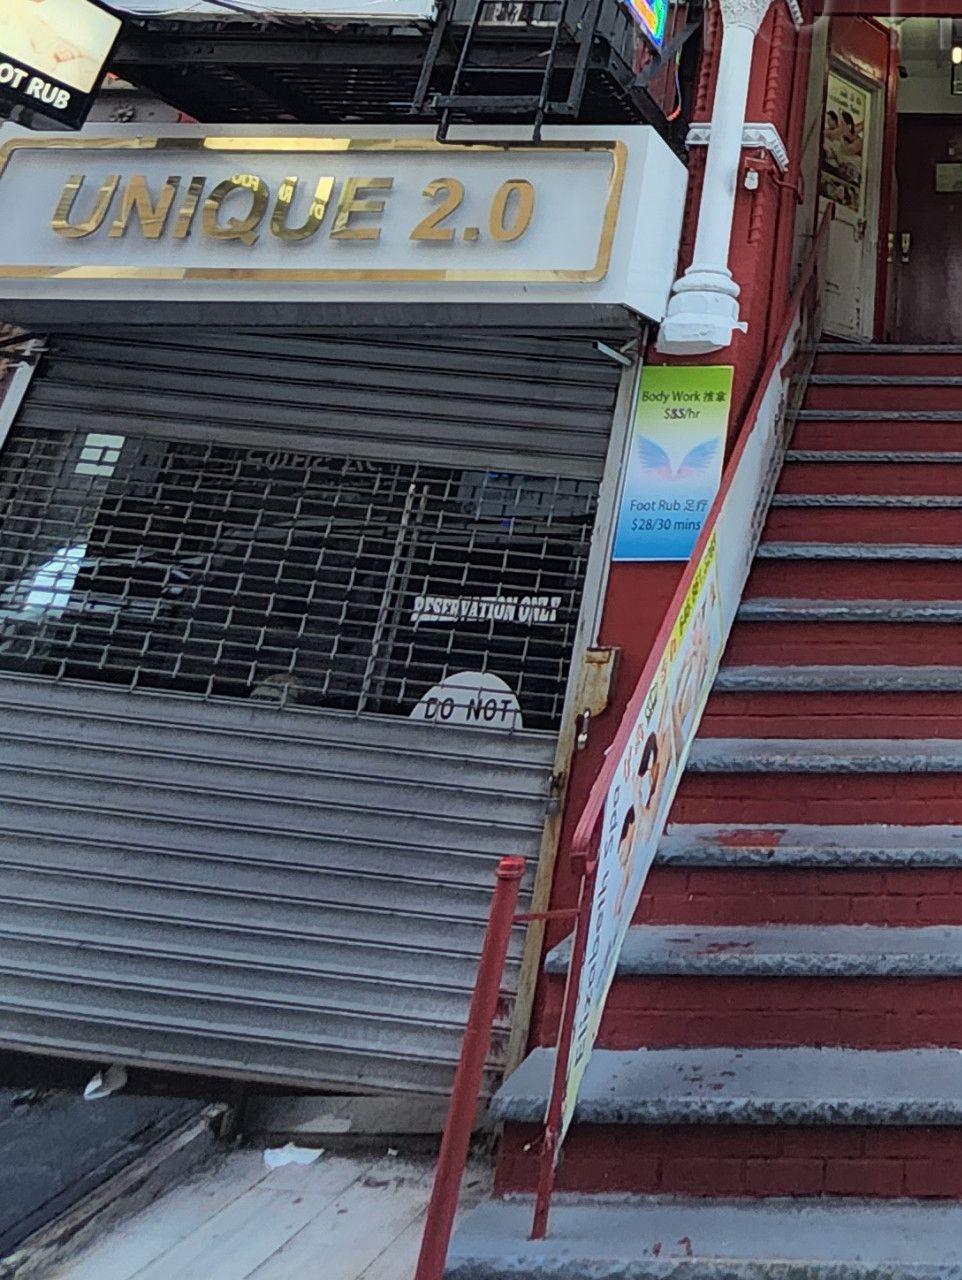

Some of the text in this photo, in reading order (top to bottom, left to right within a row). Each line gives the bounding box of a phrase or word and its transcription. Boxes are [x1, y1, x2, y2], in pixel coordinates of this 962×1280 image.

[25, 76, 71, 110] RUB
[52, 174, 535, 246] UNIQUE 2.0
[642, 390, 670, 404] Body
[672, 390, 700, 402] Work
[630, 499, 657, 511] Foot
[659, 499, 681, 511] Rub
[631, 518, 702, 531] $28/30 mins
[410, 596, 516, 622] RESERVATION
[424, 696, 513, 722] DO NOT
